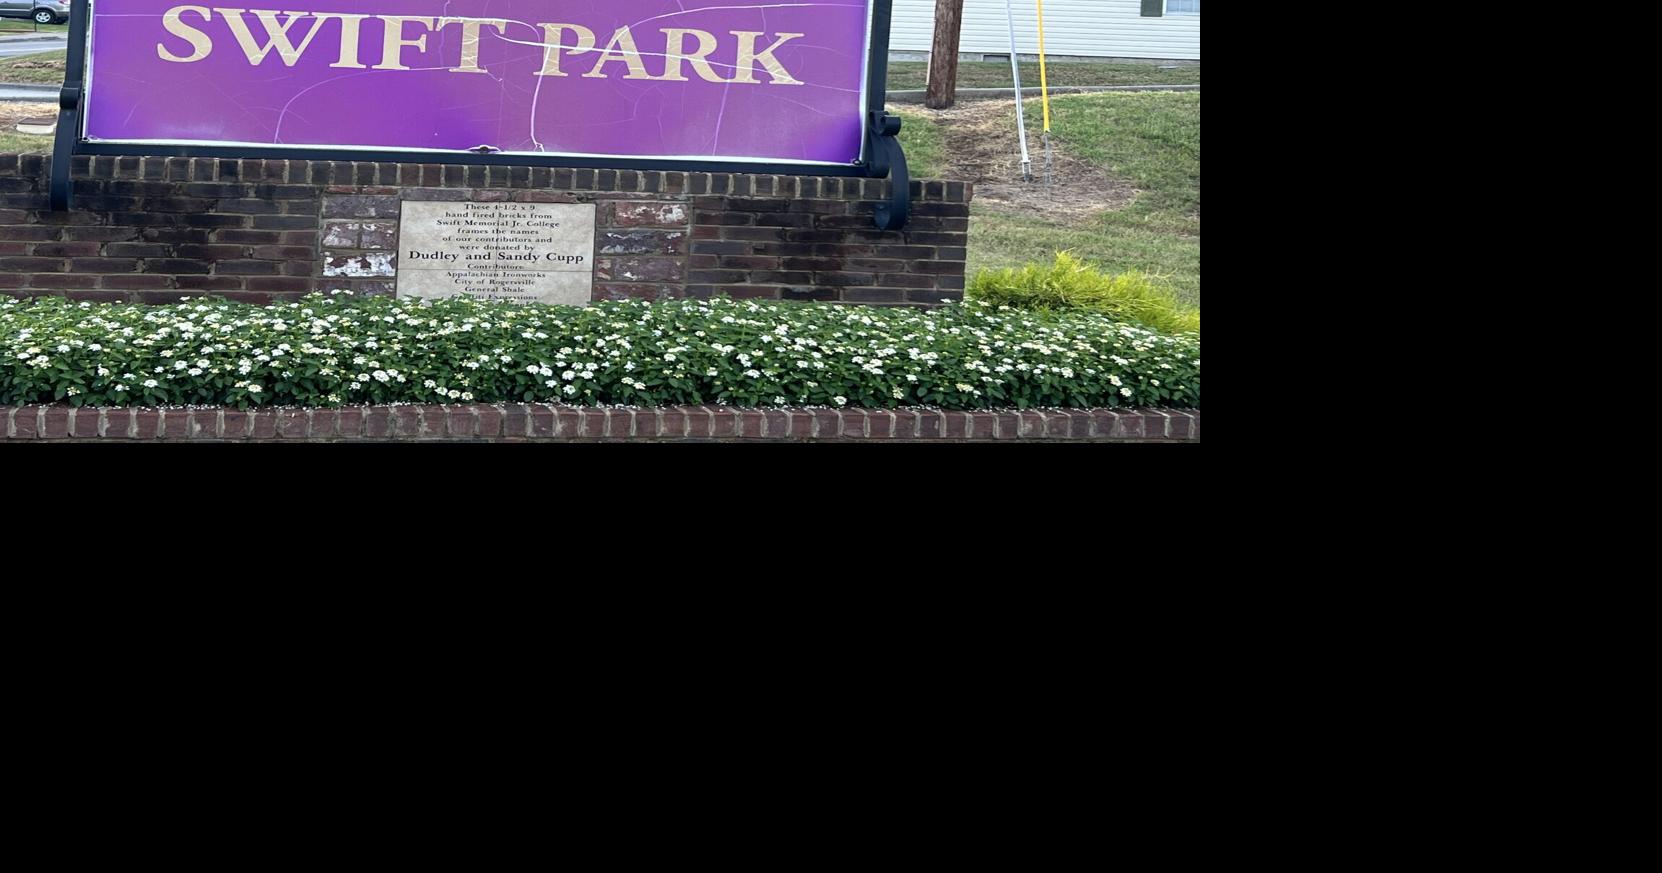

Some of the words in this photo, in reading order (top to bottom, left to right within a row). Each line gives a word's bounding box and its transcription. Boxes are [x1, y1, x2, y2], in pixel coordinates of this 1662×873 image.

[157, 5, 505, 74] SWIFT
[533, 22, 804, 86] PARK
[409, 251, 459, 262] Dudley
[465, 252, 491, 260] and
[497, 252, 541, 263] Sandy
[546, 252, 584, 264] Cupp
